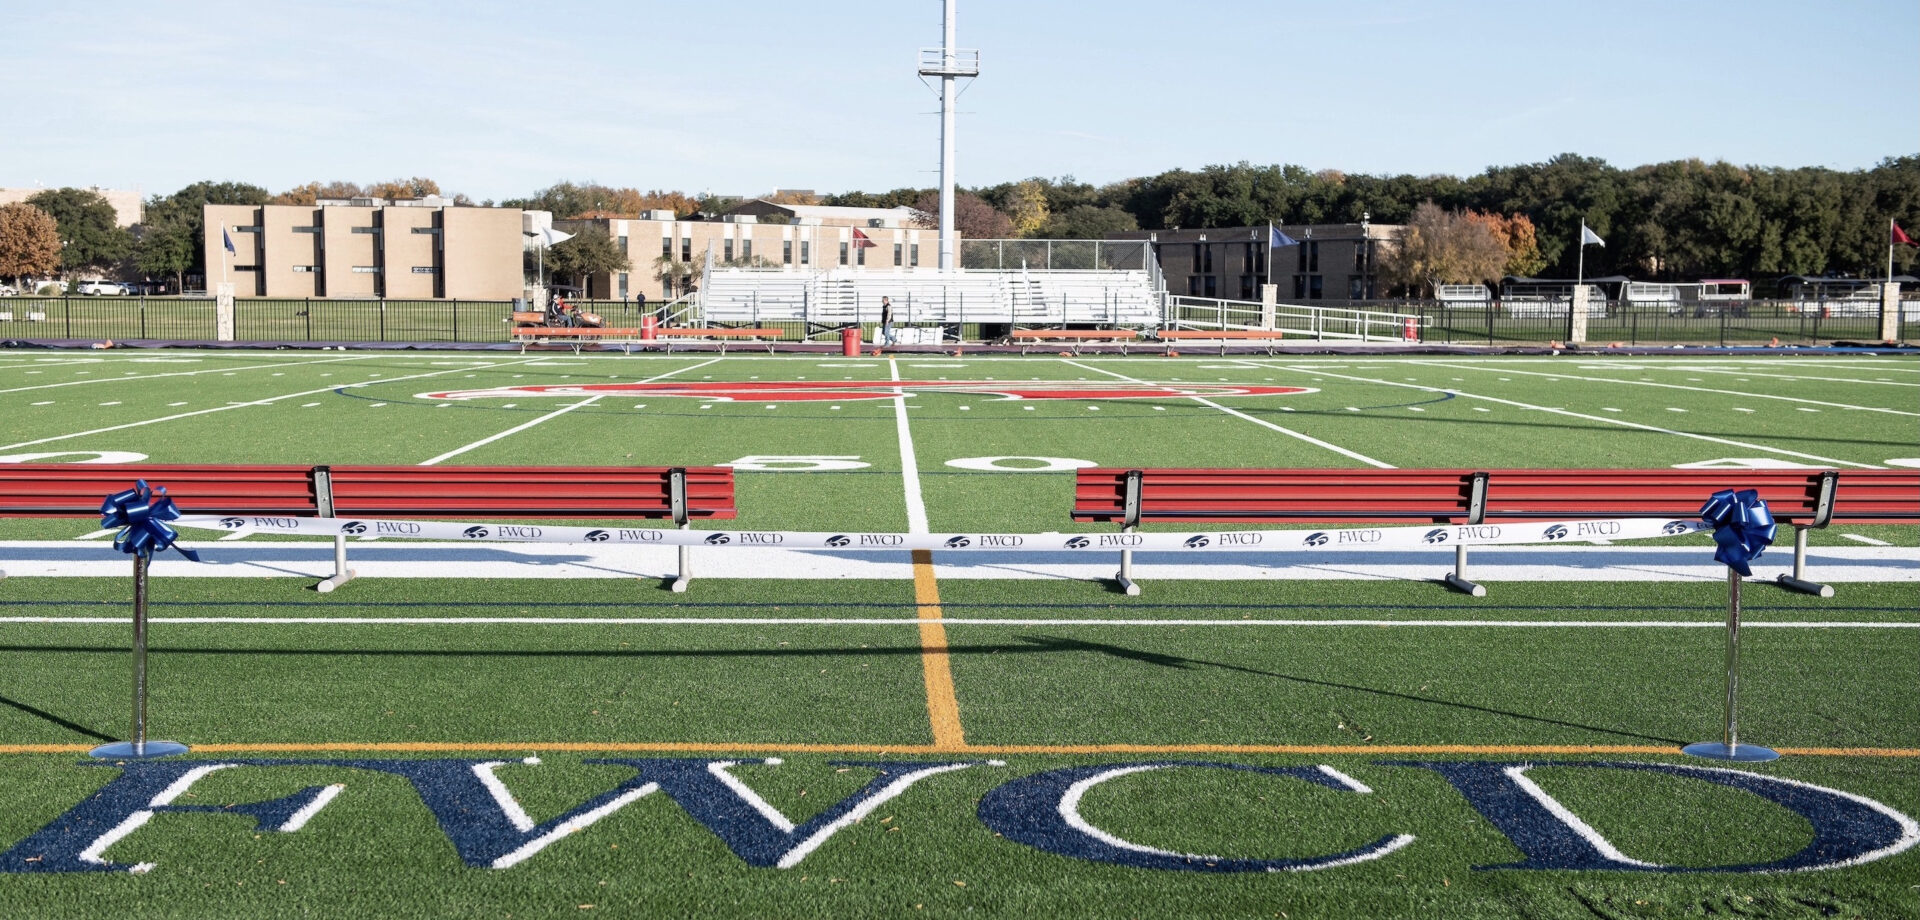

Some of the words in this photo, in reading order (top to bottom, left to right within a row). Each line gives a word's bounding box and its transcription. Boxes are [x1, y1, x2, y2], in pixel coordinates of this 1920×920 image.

[254, 517, 299, 529] FWCD
[376, 521, 421, 534] FWCD
[1577, 521, 1621, 535] FWCD
[498, 526, 542, 538] FWCD
[619, 529, 663, 541] FWCD
[1337, 530, 1382, 543] FWCD
[1457, 526, 1501, 539] FWCD
[739, 533, 783, 544] FWCD
[860, 534, 903, 545] FWCD
[979, 535, 1023, 546] FWCD
[1099, 534, 1143, 546] FWCD
[1218, 533, 1262, 545] FWCD
[0, 757, 1920, 873] FWCD
